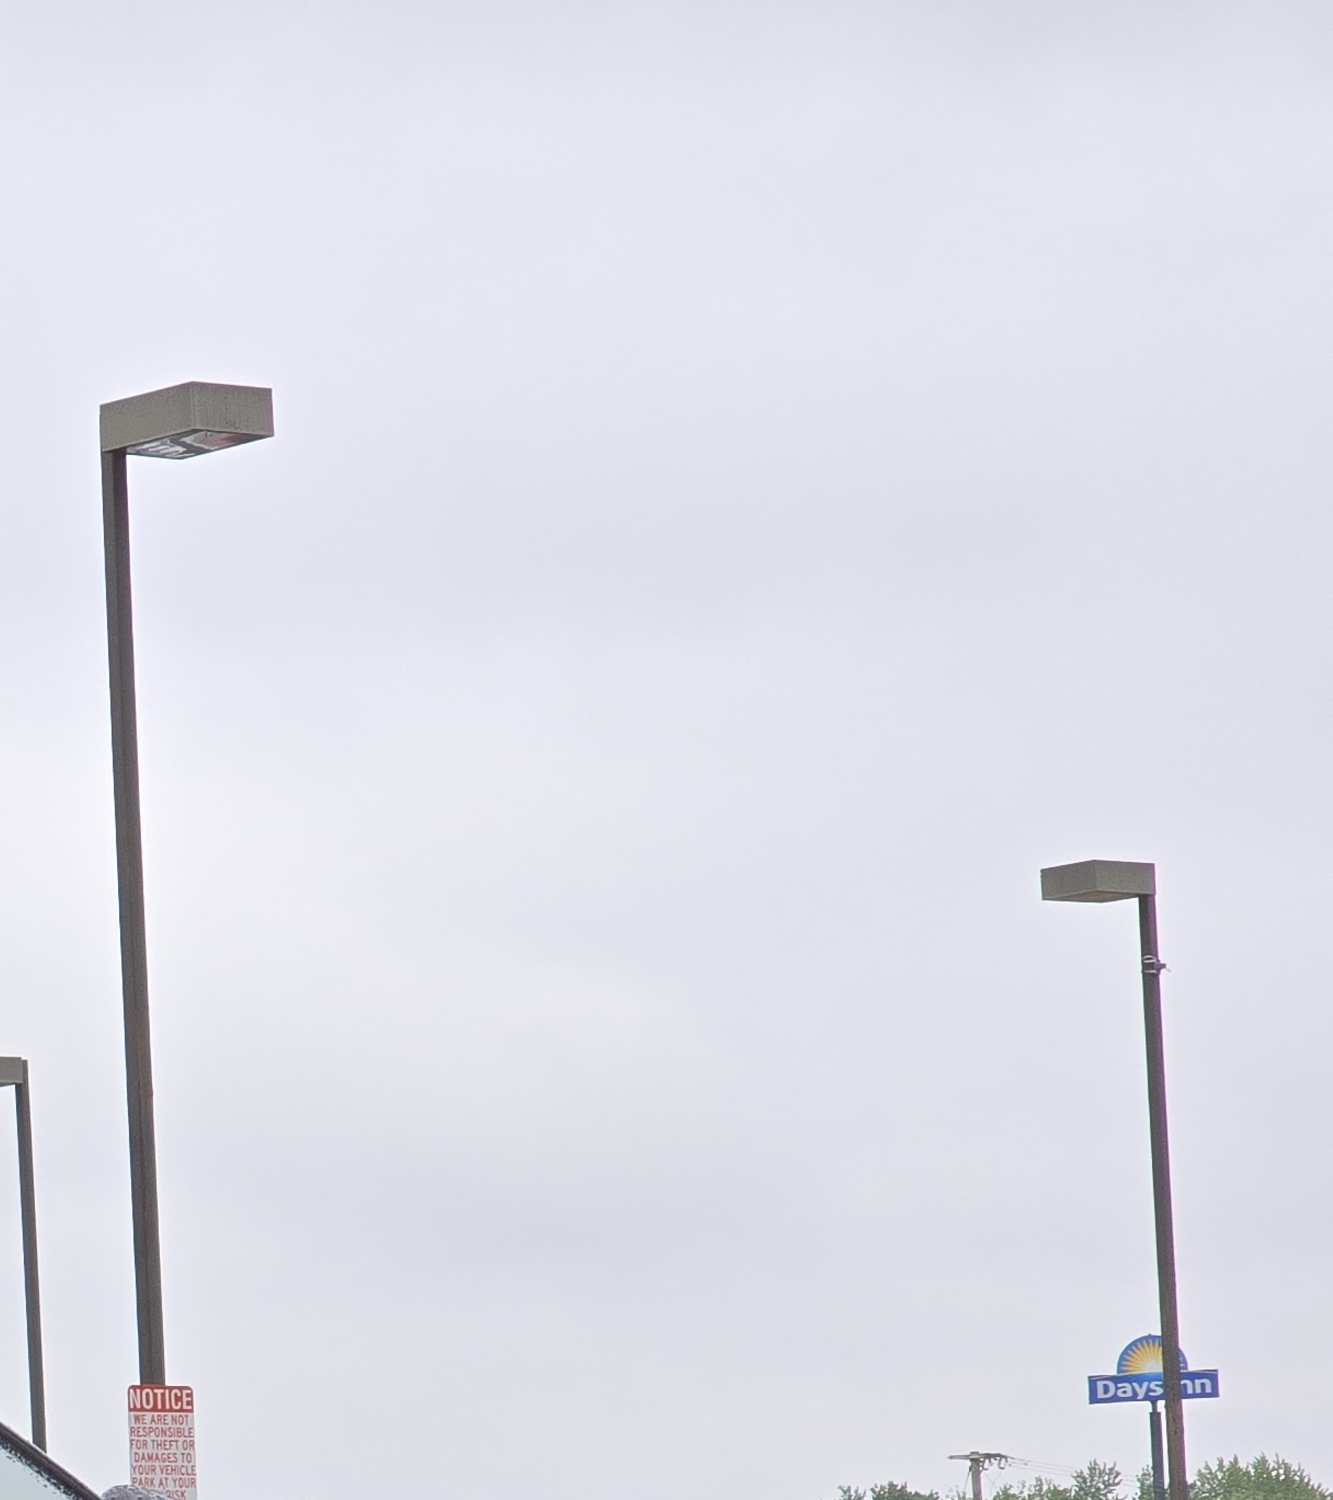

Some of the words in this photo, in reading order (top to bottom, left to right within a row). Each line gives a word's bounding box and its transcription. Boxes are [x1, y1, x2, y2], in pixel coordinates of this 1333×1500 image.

[1096, 1379, 1164, 1400] Days
[130, 1388, 193, 1410] NOTICE
[133, 1414, 148, 1425] WE
[150, 1414, 169, 1425] ARE
[171, 1414, 190, 1426] NOT
[130, 1426, 195, 1438] RESPONSIBLE
[130, 1439, 149, 1450] FOR
[151, 1439, 180, 1451] THEFT
[182, 1439, 196, 1451] OR
[134, 1452, 179, 1463] DAMAGES
[180, 1452, 193, 1464] TO
[130, 1465, 157, 1476] YOUR
[158, 1464, 197, 1476] VEHICLE
[131, 1476, 156, 1488] PARK
[158, 1477, 169, 1489] AT
[172, 1477, 197, 1489] YOUR
